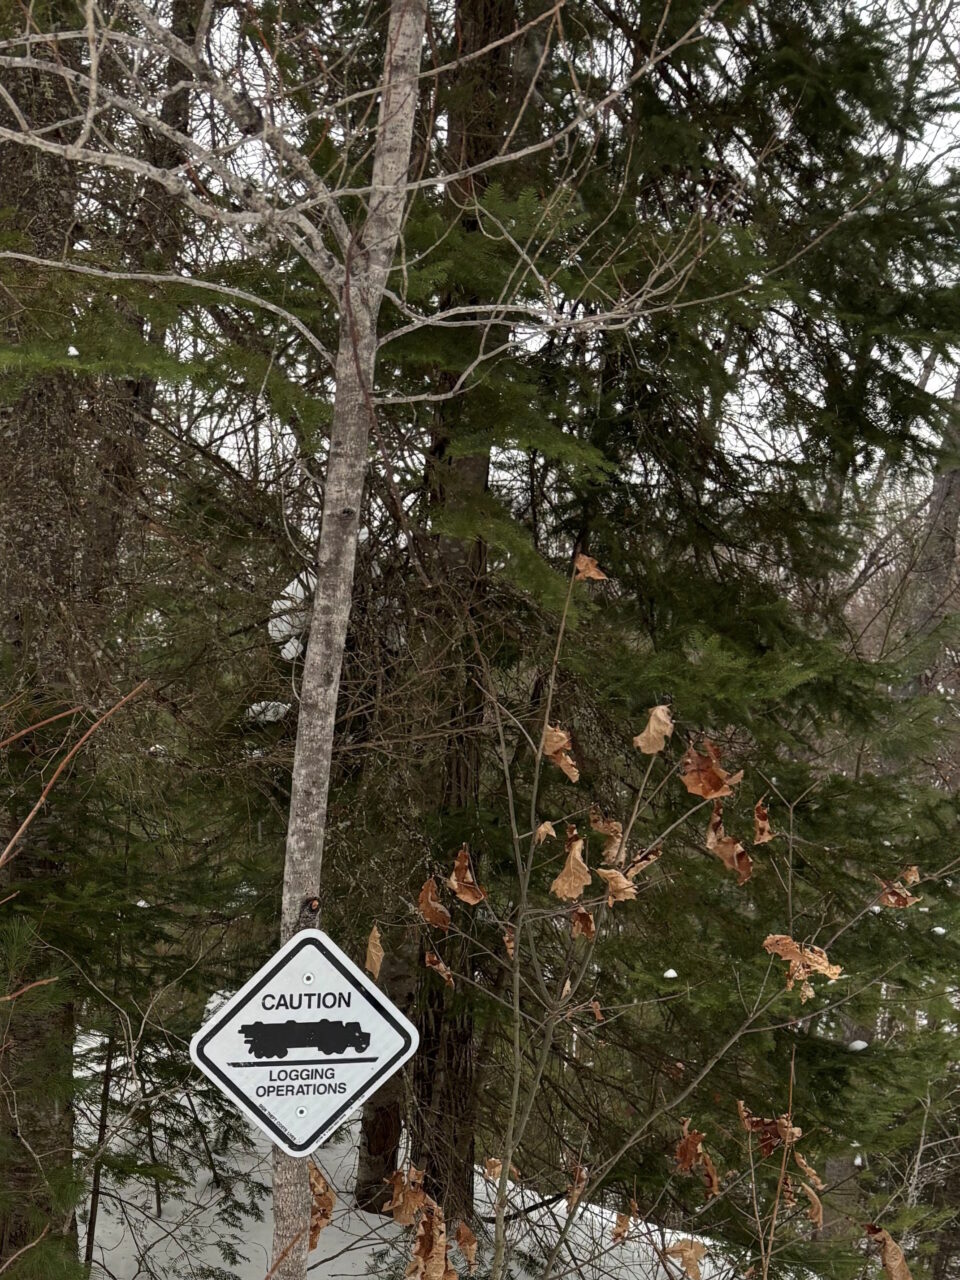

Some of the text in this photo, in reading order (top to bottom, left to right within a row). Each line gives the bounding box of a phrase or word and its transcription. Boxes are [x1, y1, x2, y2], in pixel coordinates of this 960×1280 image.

[261, 992, 352, 1011] CAUTION
[269, 1068, 336, 1082] LOGGING
[255, 1082, 347, 1098] OPERATIONS
[266, 1111, 278, 1122] THEFT
